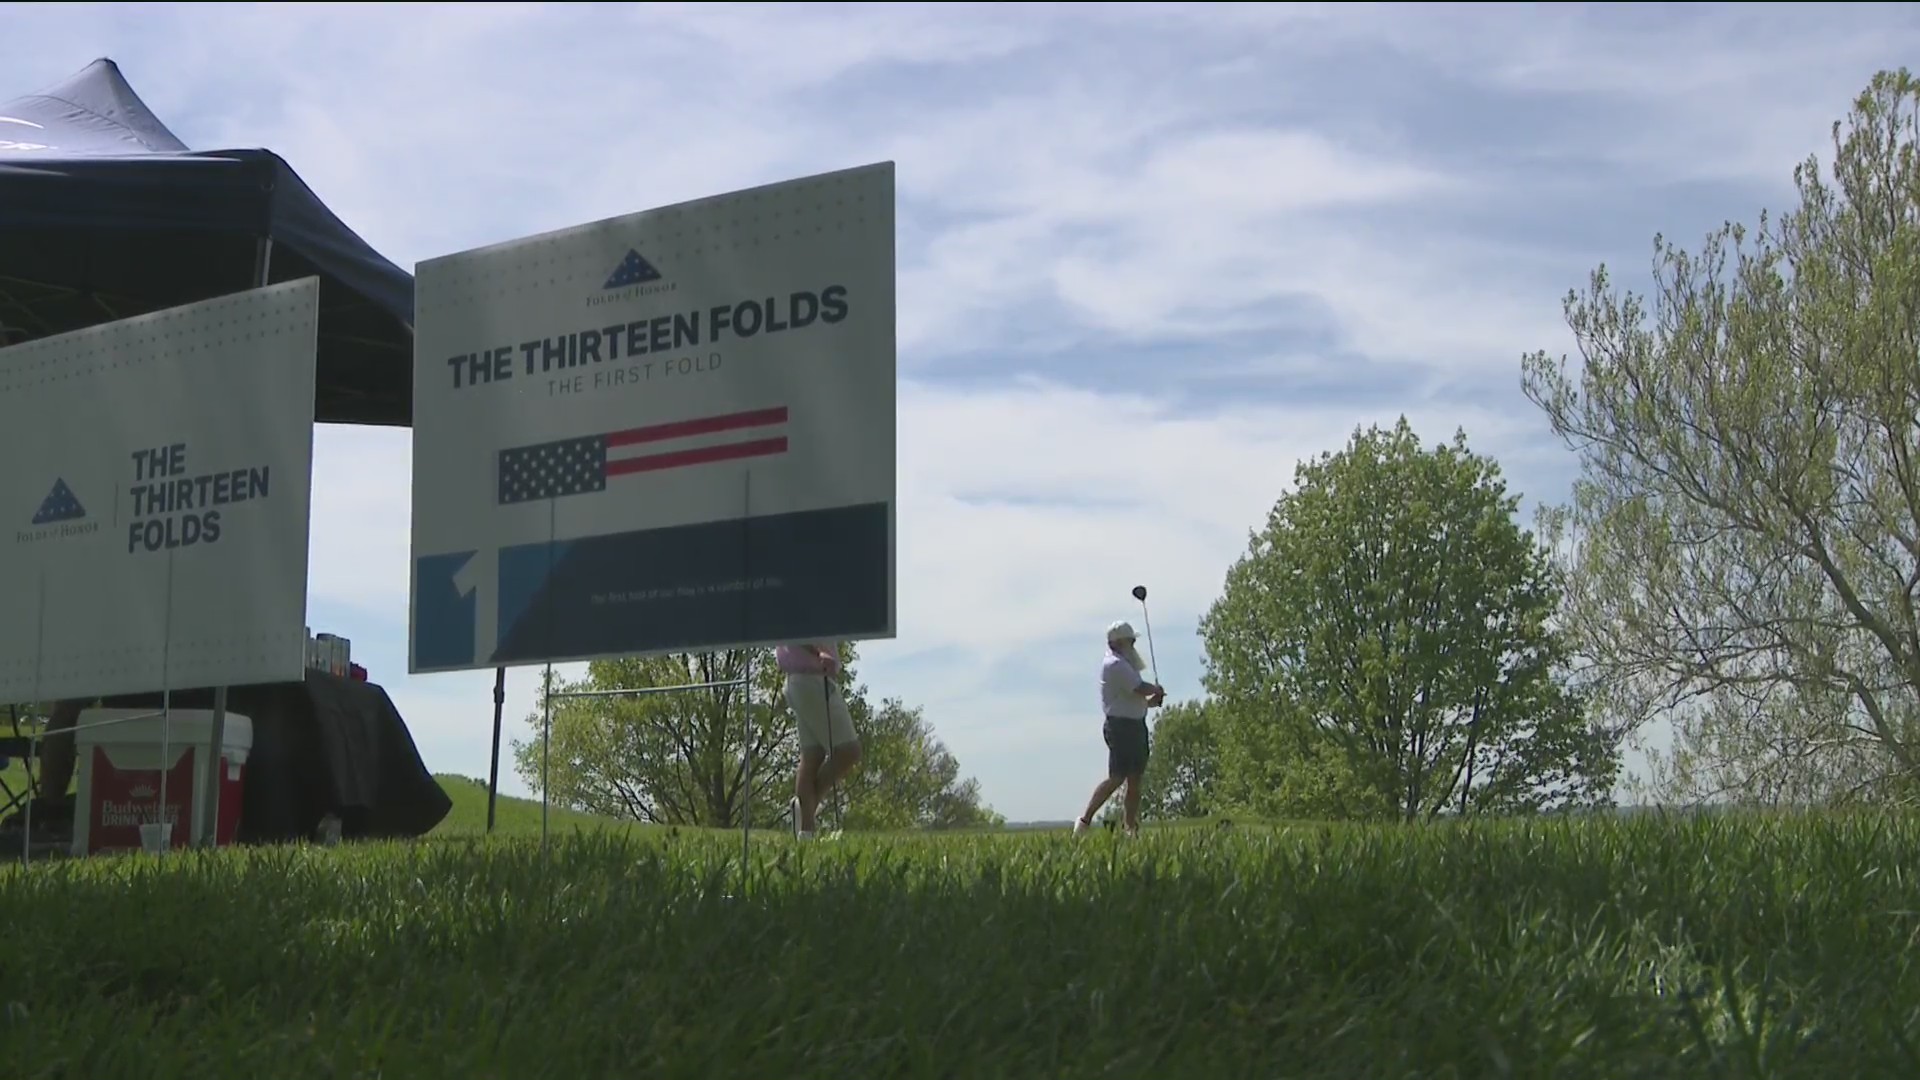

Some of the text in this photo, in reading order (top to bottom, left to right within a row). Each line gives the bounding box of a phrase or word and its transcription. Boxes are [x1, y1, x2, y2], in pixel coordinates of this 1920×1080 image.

[448, 285, 849, 389] THE THIRTEEN FOLDS
[548, 352, 722, 397] THE FIRST FOLD
[132, 443, 186, 481] THE
[130, 465, 270, 517] THIRTEEN
[128, 510, 220, 553] FOLDS
[102, 814, 139, 827] DRINK
[103, 800, 181, 816] Budweier
